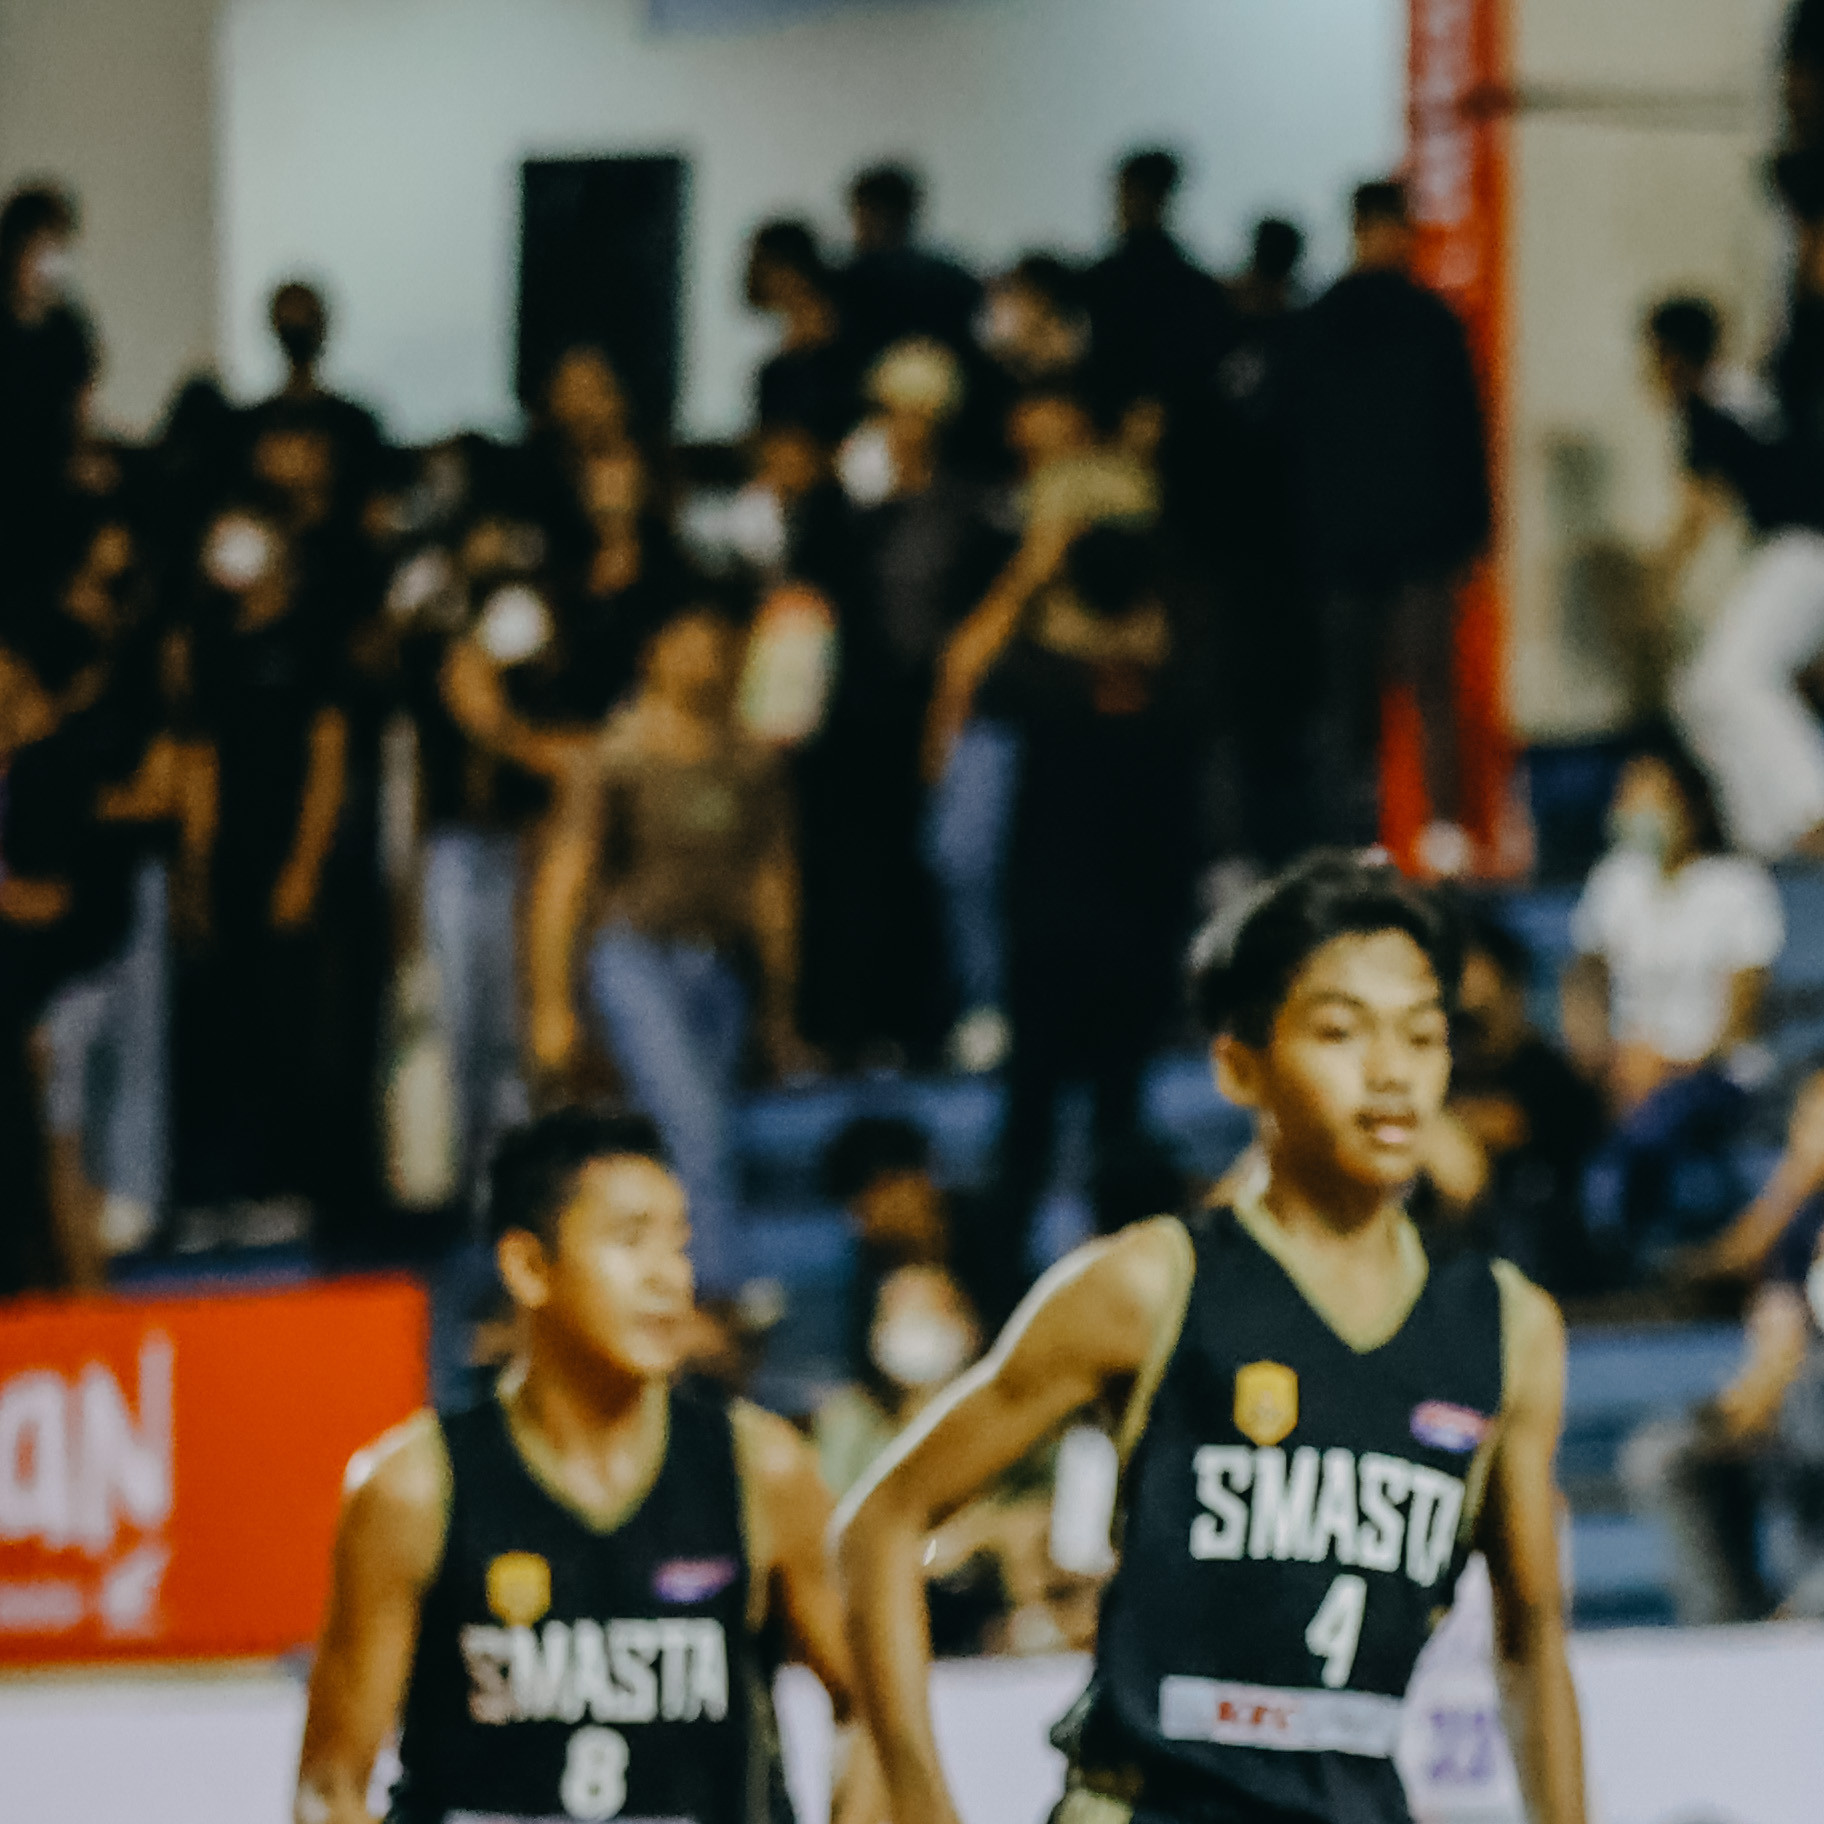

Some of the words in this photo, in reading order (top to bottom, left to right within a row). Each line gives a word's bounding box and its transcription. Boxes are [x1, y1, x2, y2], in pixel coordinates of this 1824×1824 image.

[459, 1617, 729, 1725] SMASTA
[1304, 1574, 1368, 1689] 4
[560, 1725, 629, 1821] 8
